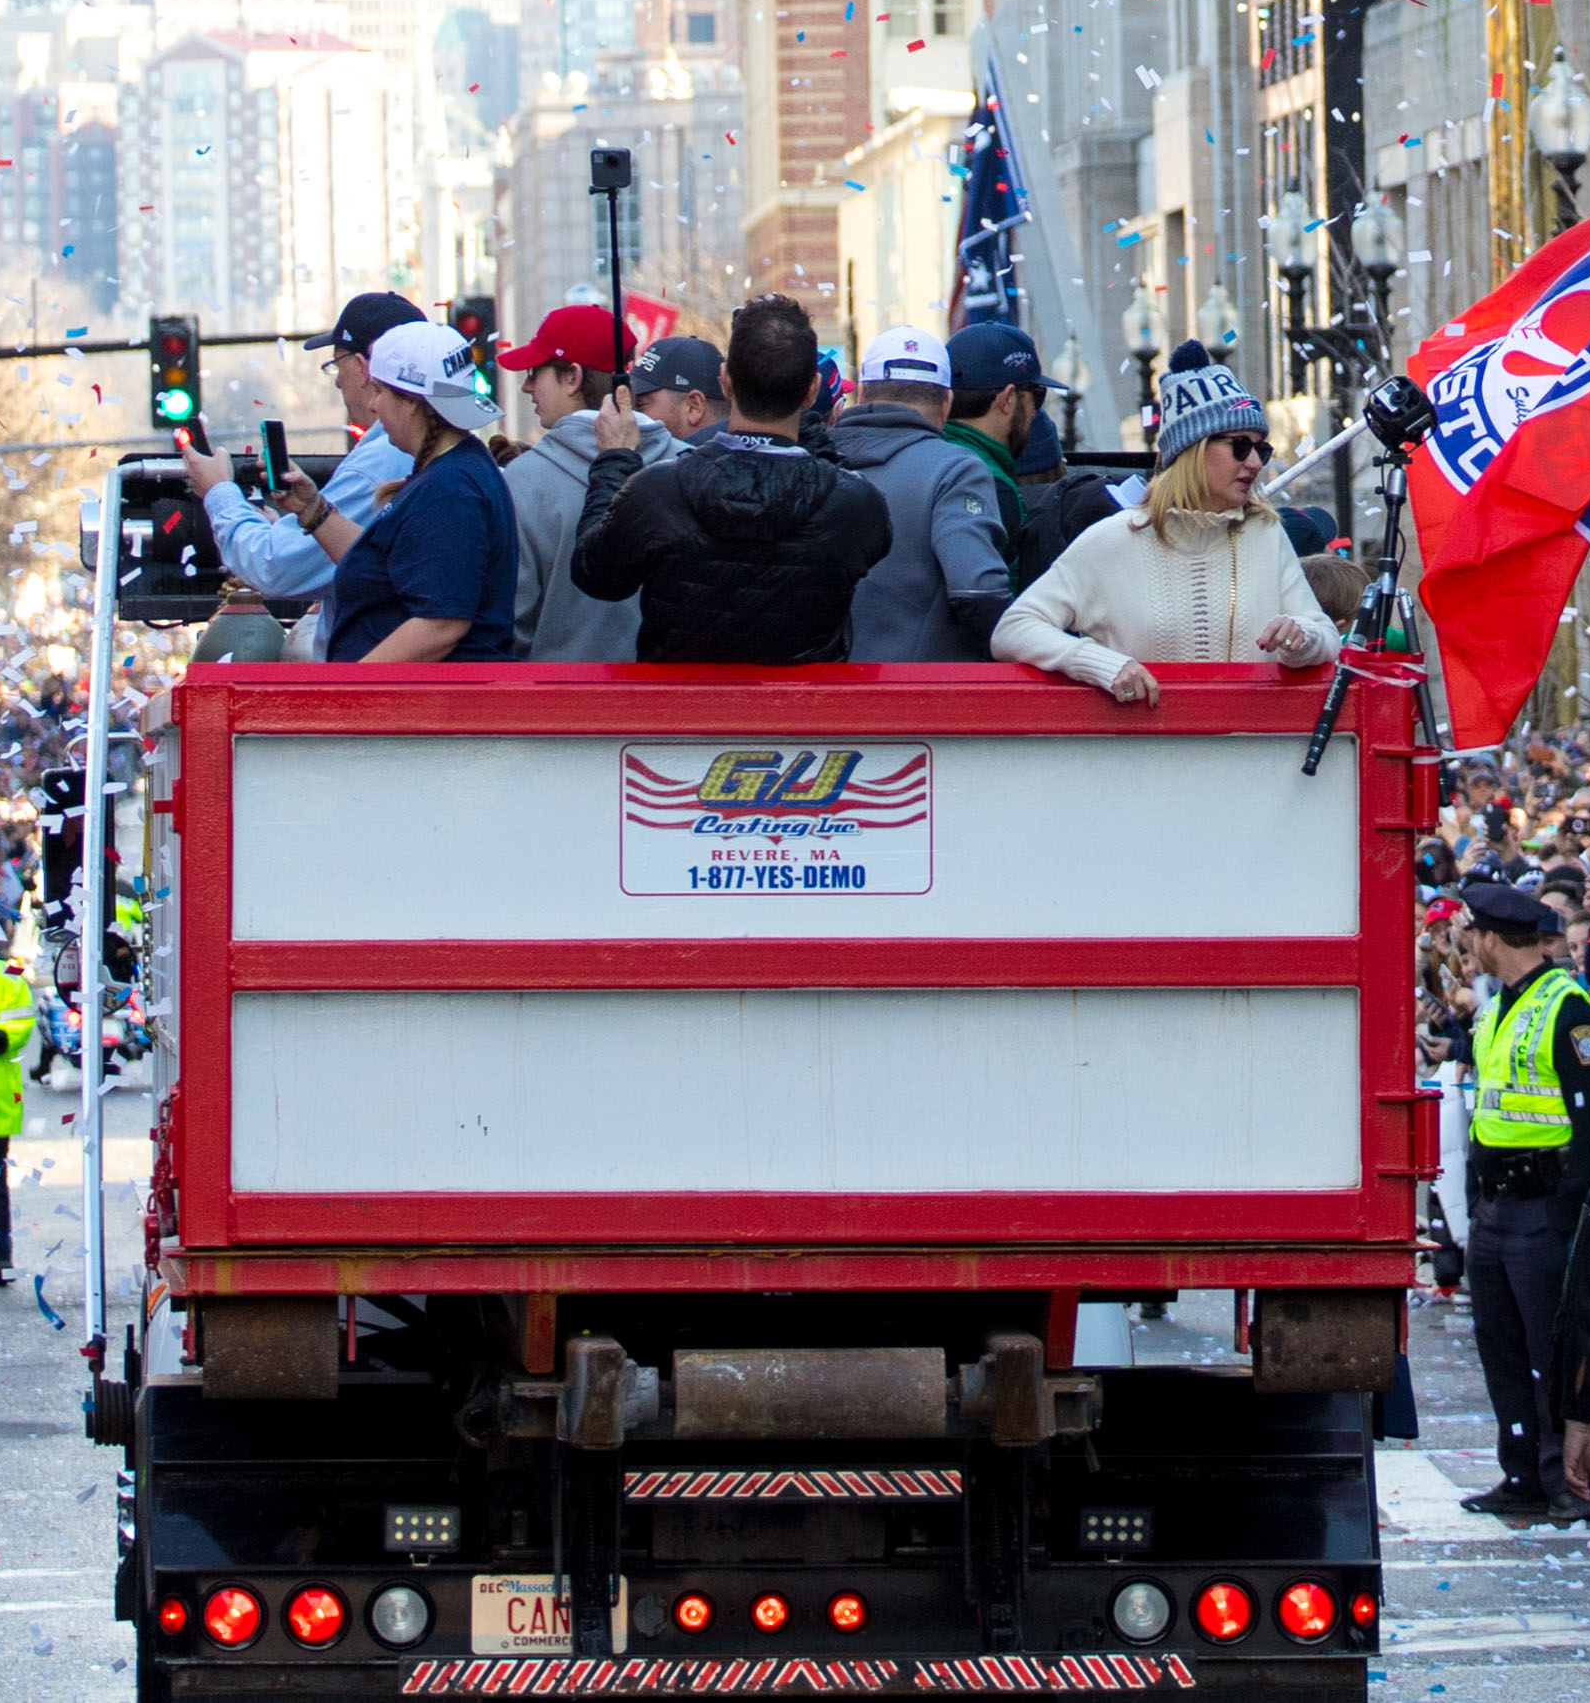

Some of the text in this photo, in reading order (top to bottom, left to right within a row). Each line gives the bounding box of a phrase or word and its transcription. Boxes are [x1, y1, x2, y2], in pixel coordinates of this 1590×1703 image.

[693, 815, 860, 839] Carting Inc.
[711, 848, 842, 863] REVERE, MA
[687, 865, 866, 890] 1-877-YES-DEMO
[480, 1583, 503, 1593] DEC
